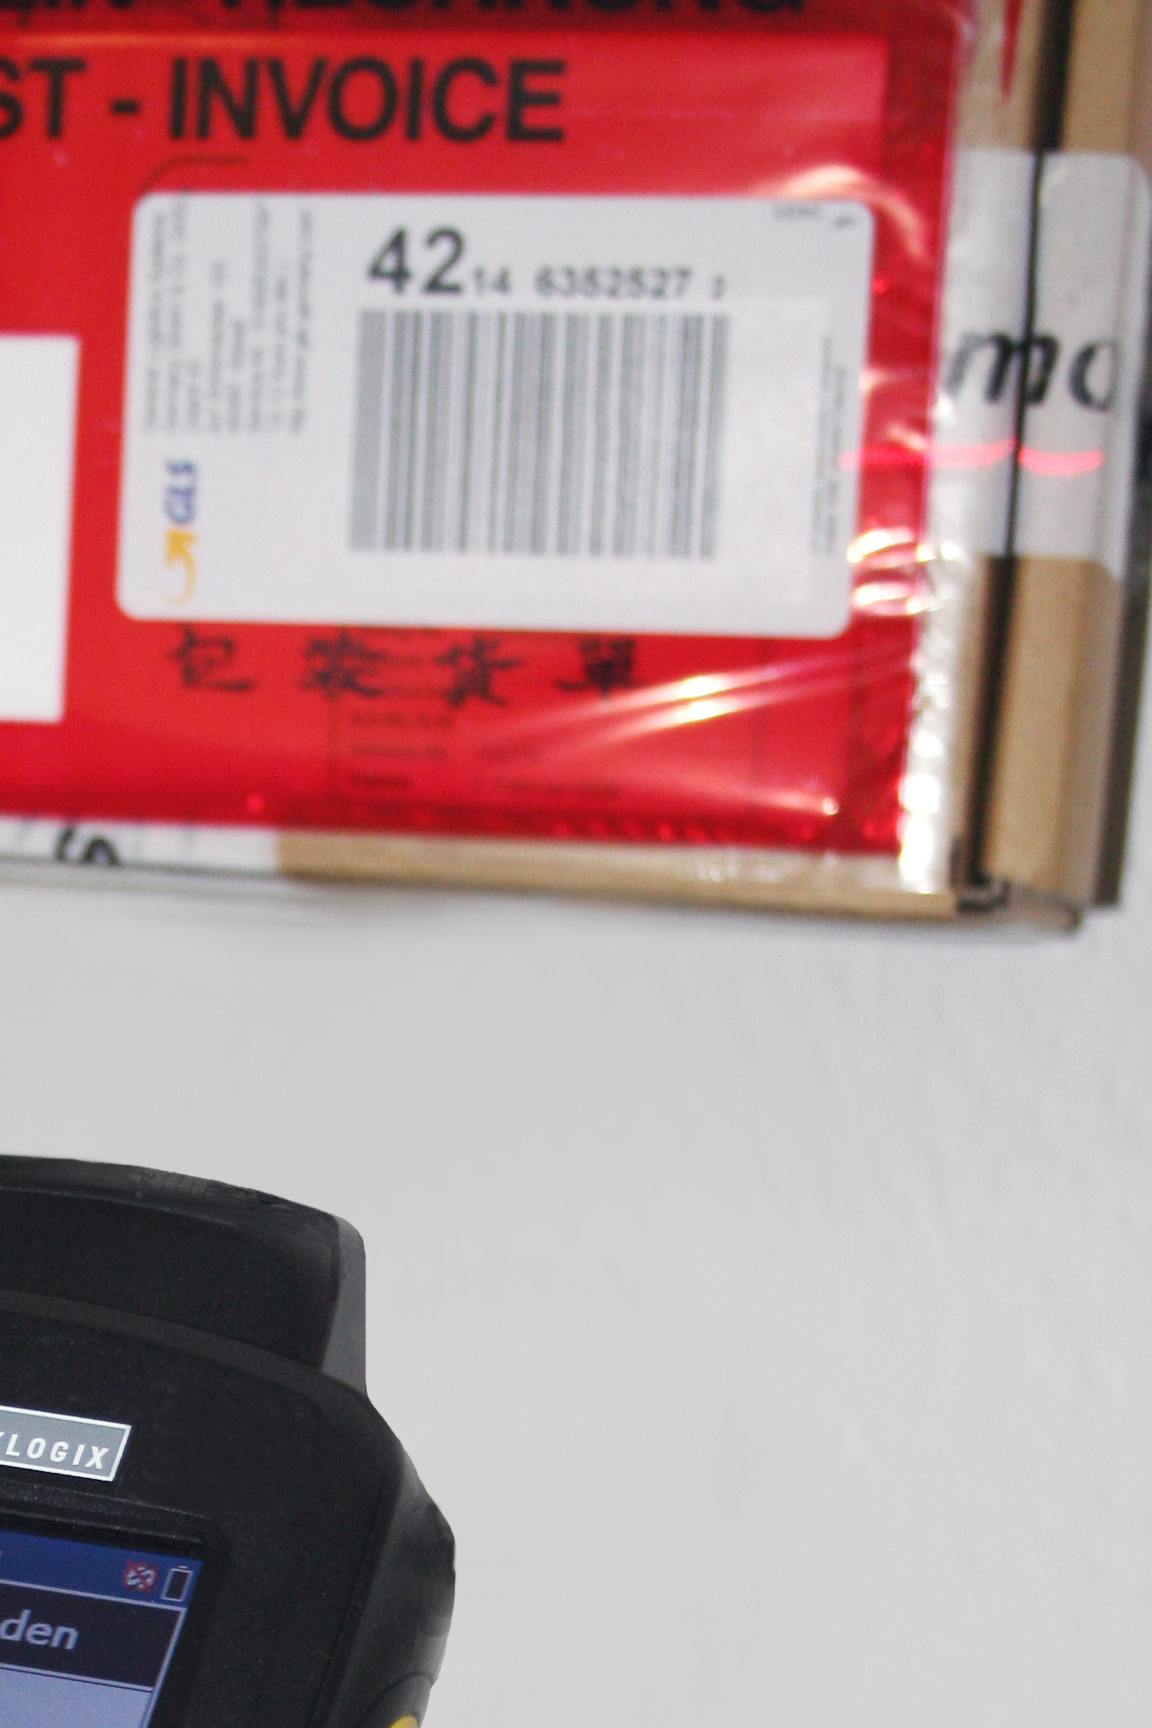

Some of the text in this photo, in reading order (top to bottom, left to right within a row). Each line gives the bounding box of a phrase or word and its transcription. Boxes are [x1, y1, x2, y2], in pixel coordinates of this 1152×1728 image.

[168, 56, 567, 143] INVOICE
[365, 224, 467, 297] 42
[473, 264, 513, 296] 14
